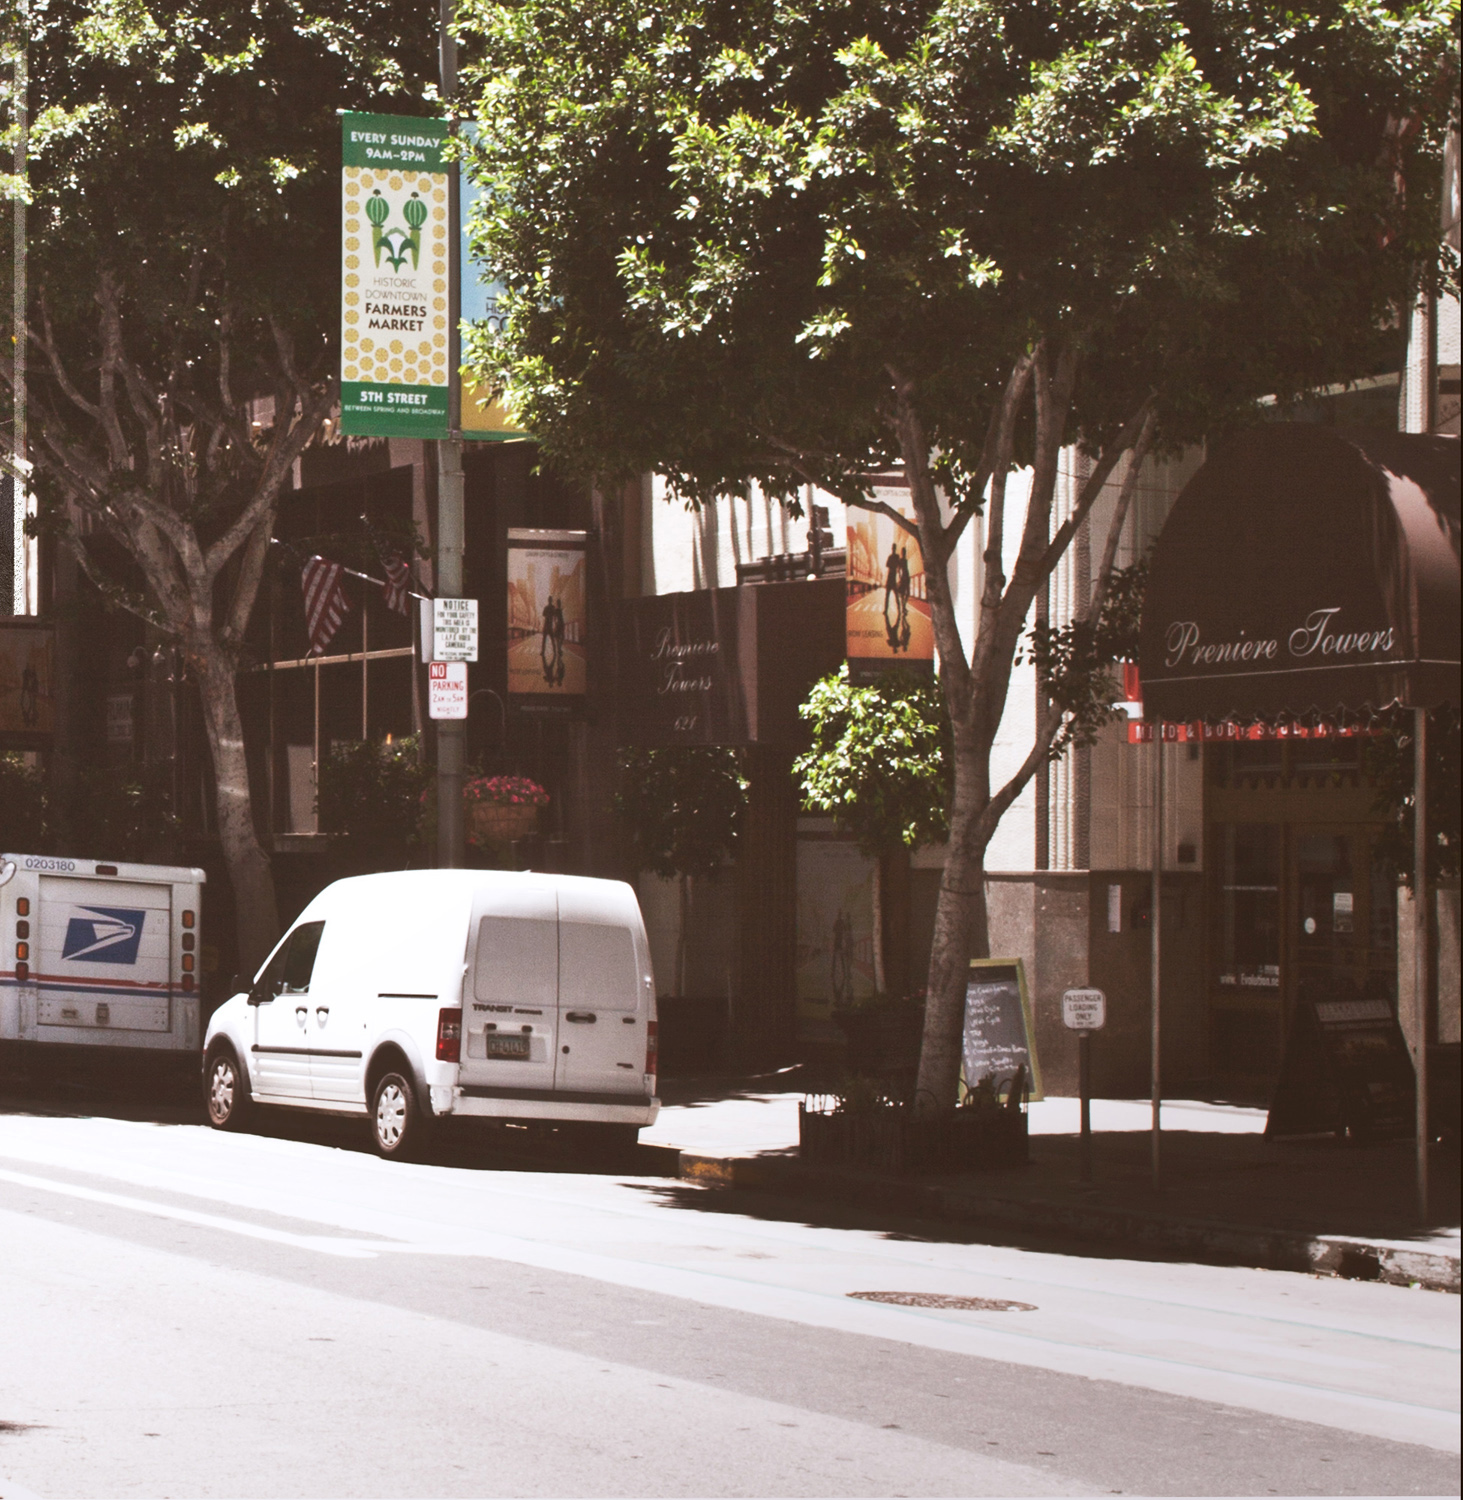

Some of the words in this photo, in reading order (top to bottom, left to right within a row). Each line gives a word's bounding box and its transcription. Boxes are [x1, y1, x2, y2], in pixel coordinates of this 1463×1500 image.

[350, 131, 387, 144] EVERY
[390, 134, 441, 149] SUNDAY
[372, 277, 417, 289] HISTORIC
[364, 289, 428, 302] DOWNTOWN
[364, 302, 428, 318] FARMERS
[368, 319, 425, 333] MARKET
[359, 390, 384, 403] 5TH
[387, 391, 429, 405] STREET
[411, 408, 446, 416] BROADWAY
[443, 600, 469, 611] NOTICE
[1288, 606, 1396, 658] Towers
[431, 664, 446, 678] NO
[657, 660, 713, 695] Towers
[432, 681, 464, 691] PARKING
[25, 857, 76, 872] 0203180
[471, 1003, 514, 1014] TRANSIT
